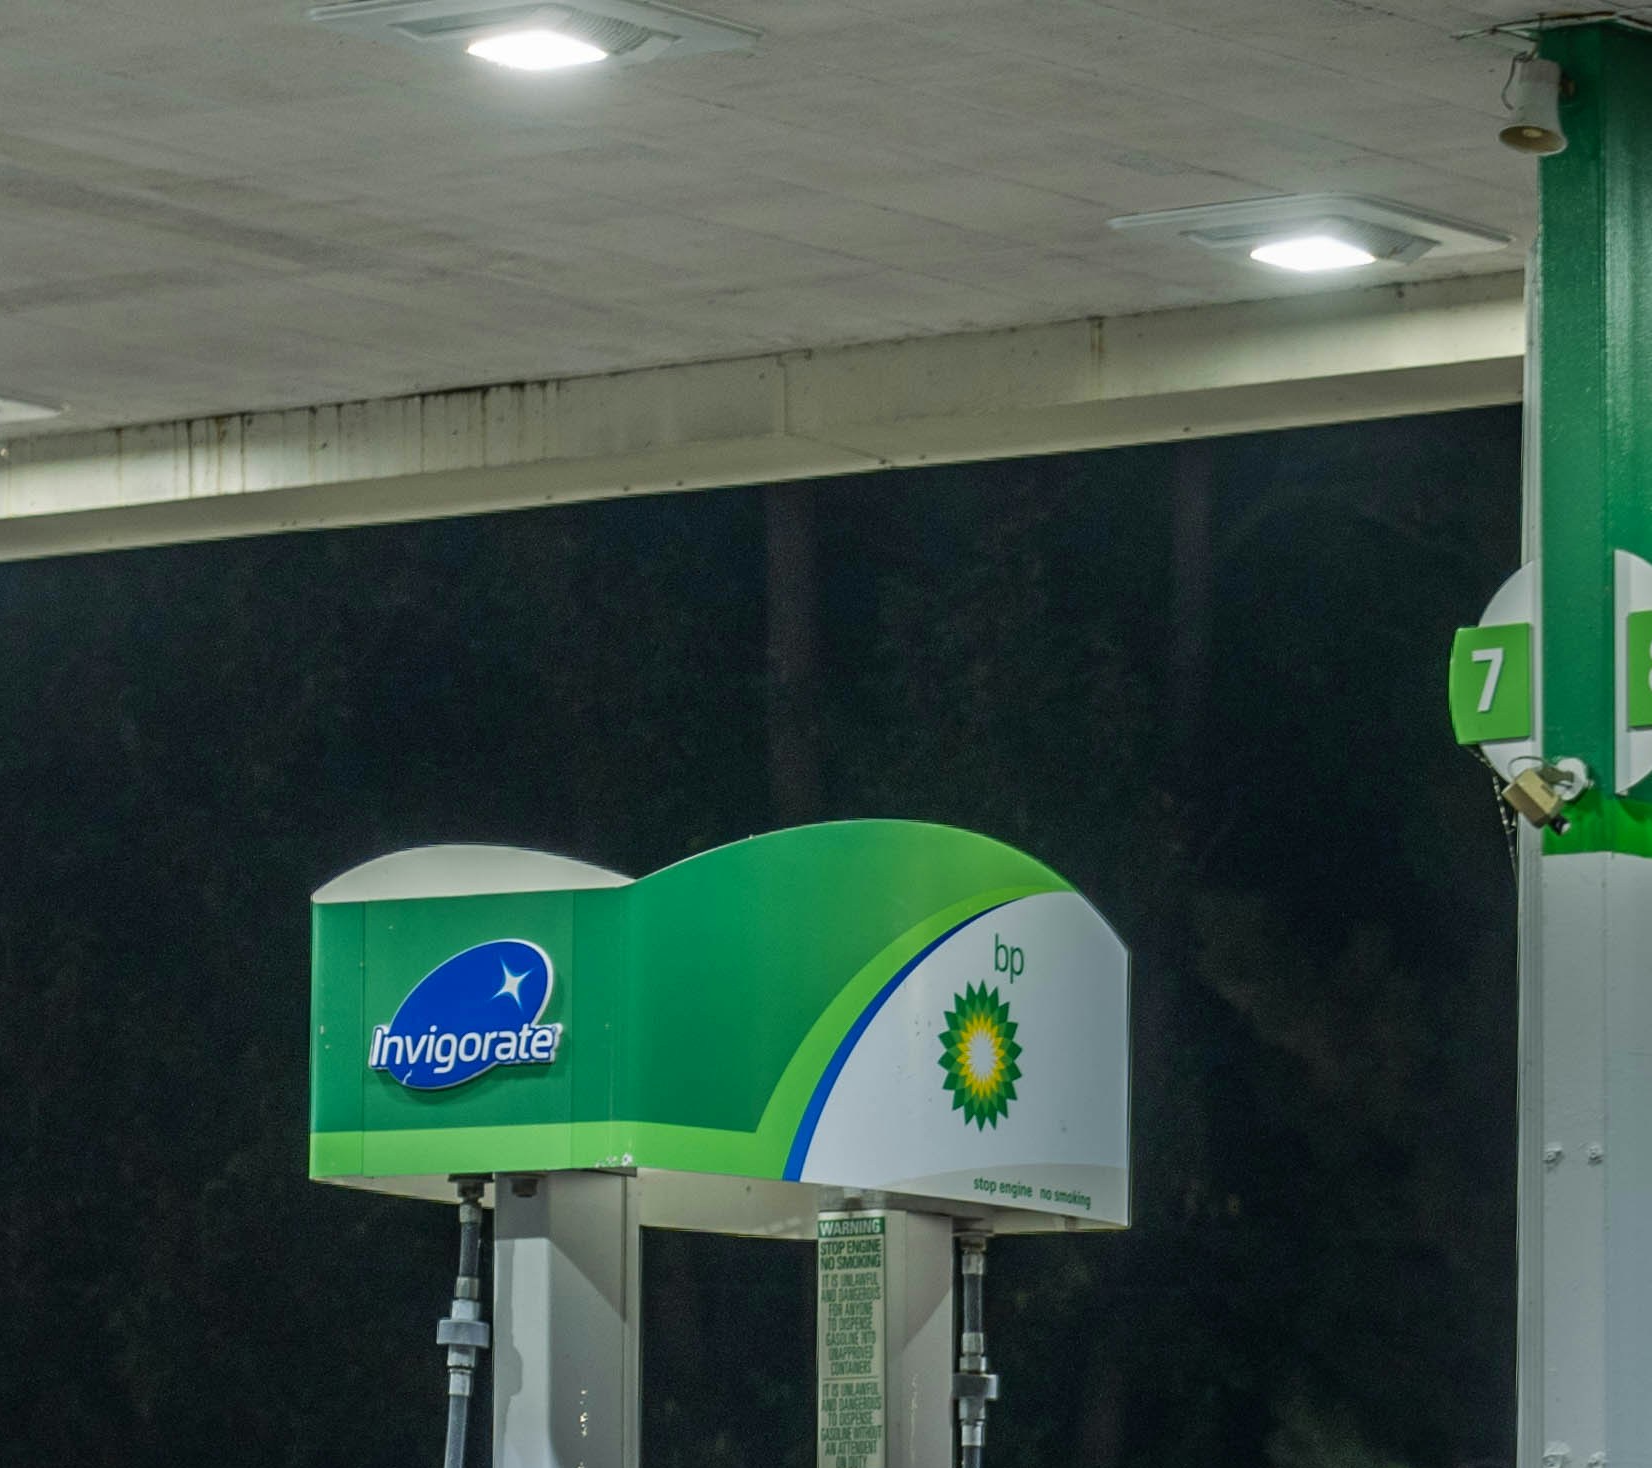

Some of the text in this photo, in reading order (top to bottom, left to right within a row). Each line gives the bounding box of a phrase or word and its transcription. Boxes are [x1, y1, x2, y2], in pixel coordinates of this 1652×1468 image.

[1471, 647, 1504, 713] 7
[995, 933, 1025, 983] bp
[370, 1022, 555, 1075] Invigorate
[973, 1177, 1092, 1210] stop engine no smoking
[819, 1219, 881, 1237] WARNING
[820, 1239, 881, 1256] STOP ENGINE
[820, 1254, 881, 1271] NO SMOKING
